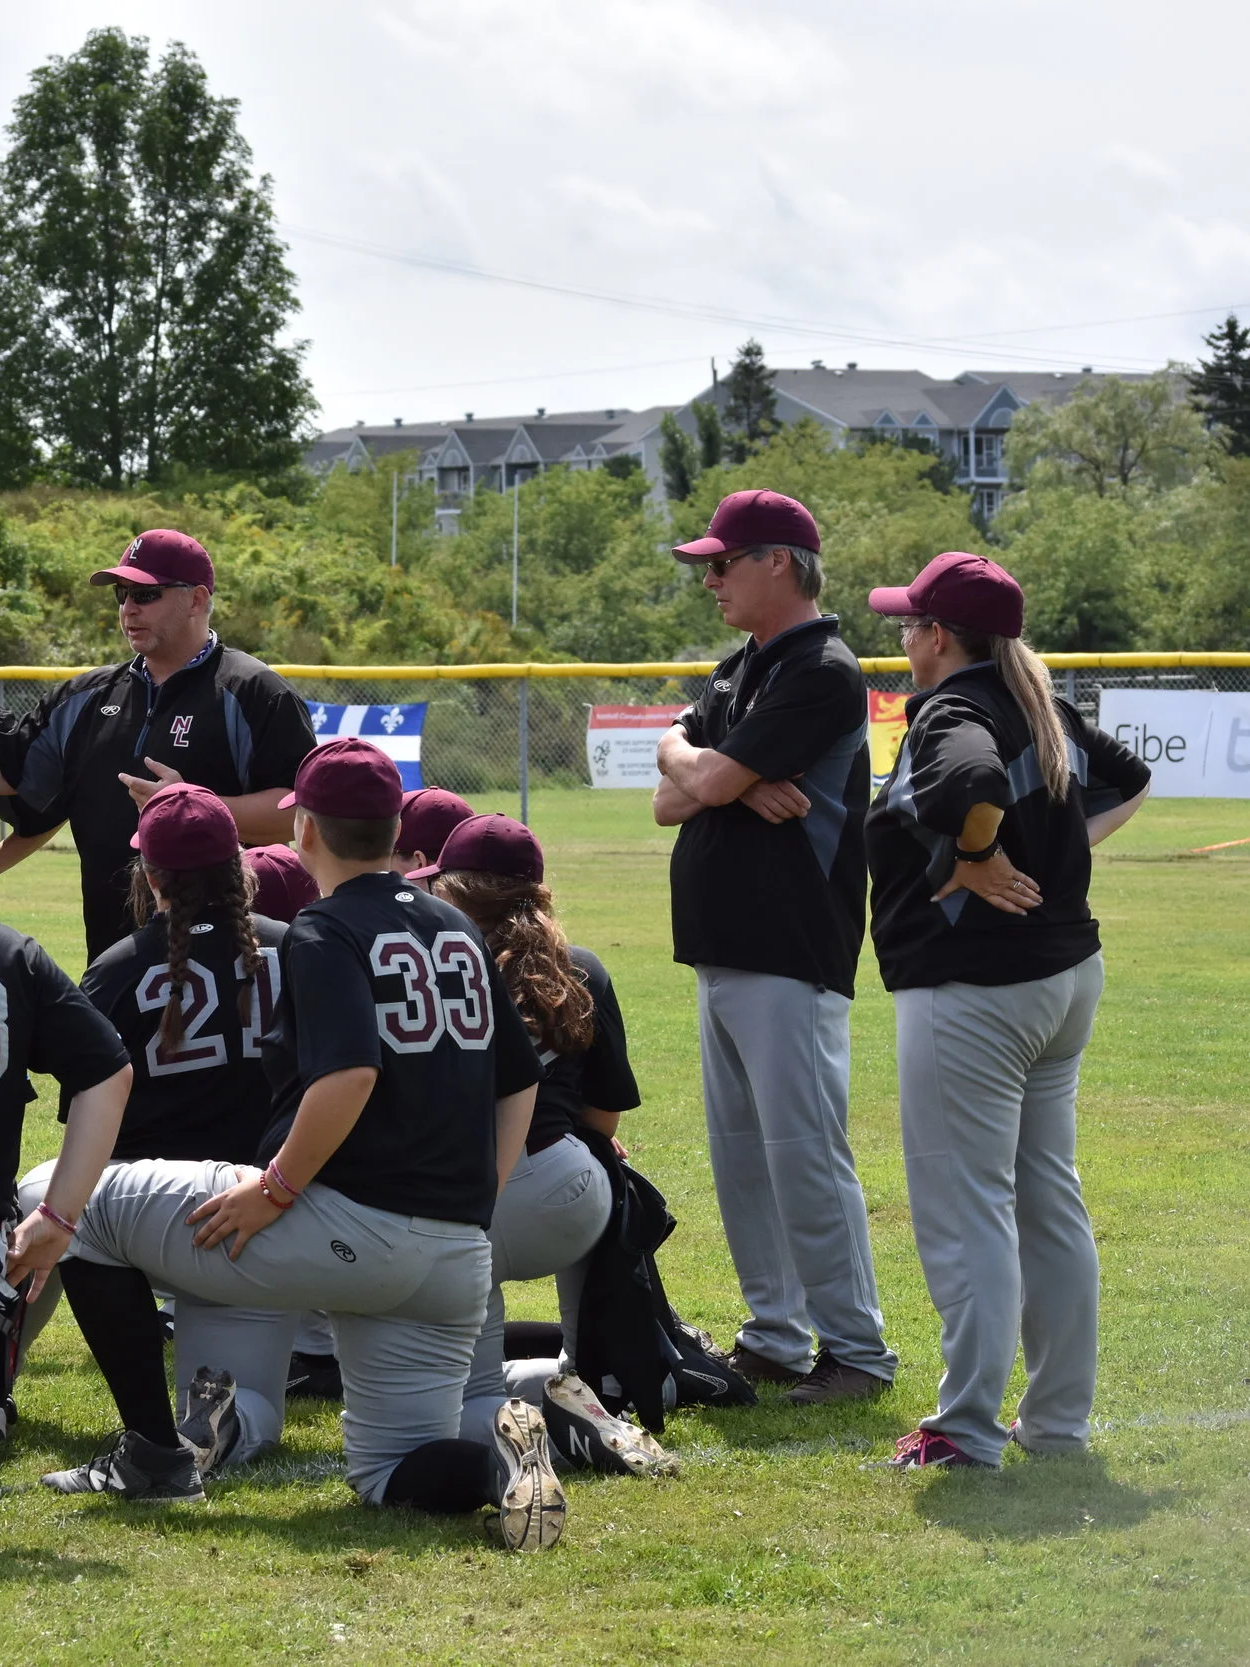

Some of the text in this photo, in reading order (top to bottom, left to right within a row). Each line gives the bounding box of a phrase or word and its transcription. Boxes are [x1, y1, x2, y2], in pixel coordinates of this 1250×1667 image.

[170, 715, 194, 747] NL
[1115, 723, 1187, 763] Fibe
[135, 946, 282, 1077] 21
[369, 931, 495, 1054] 33
